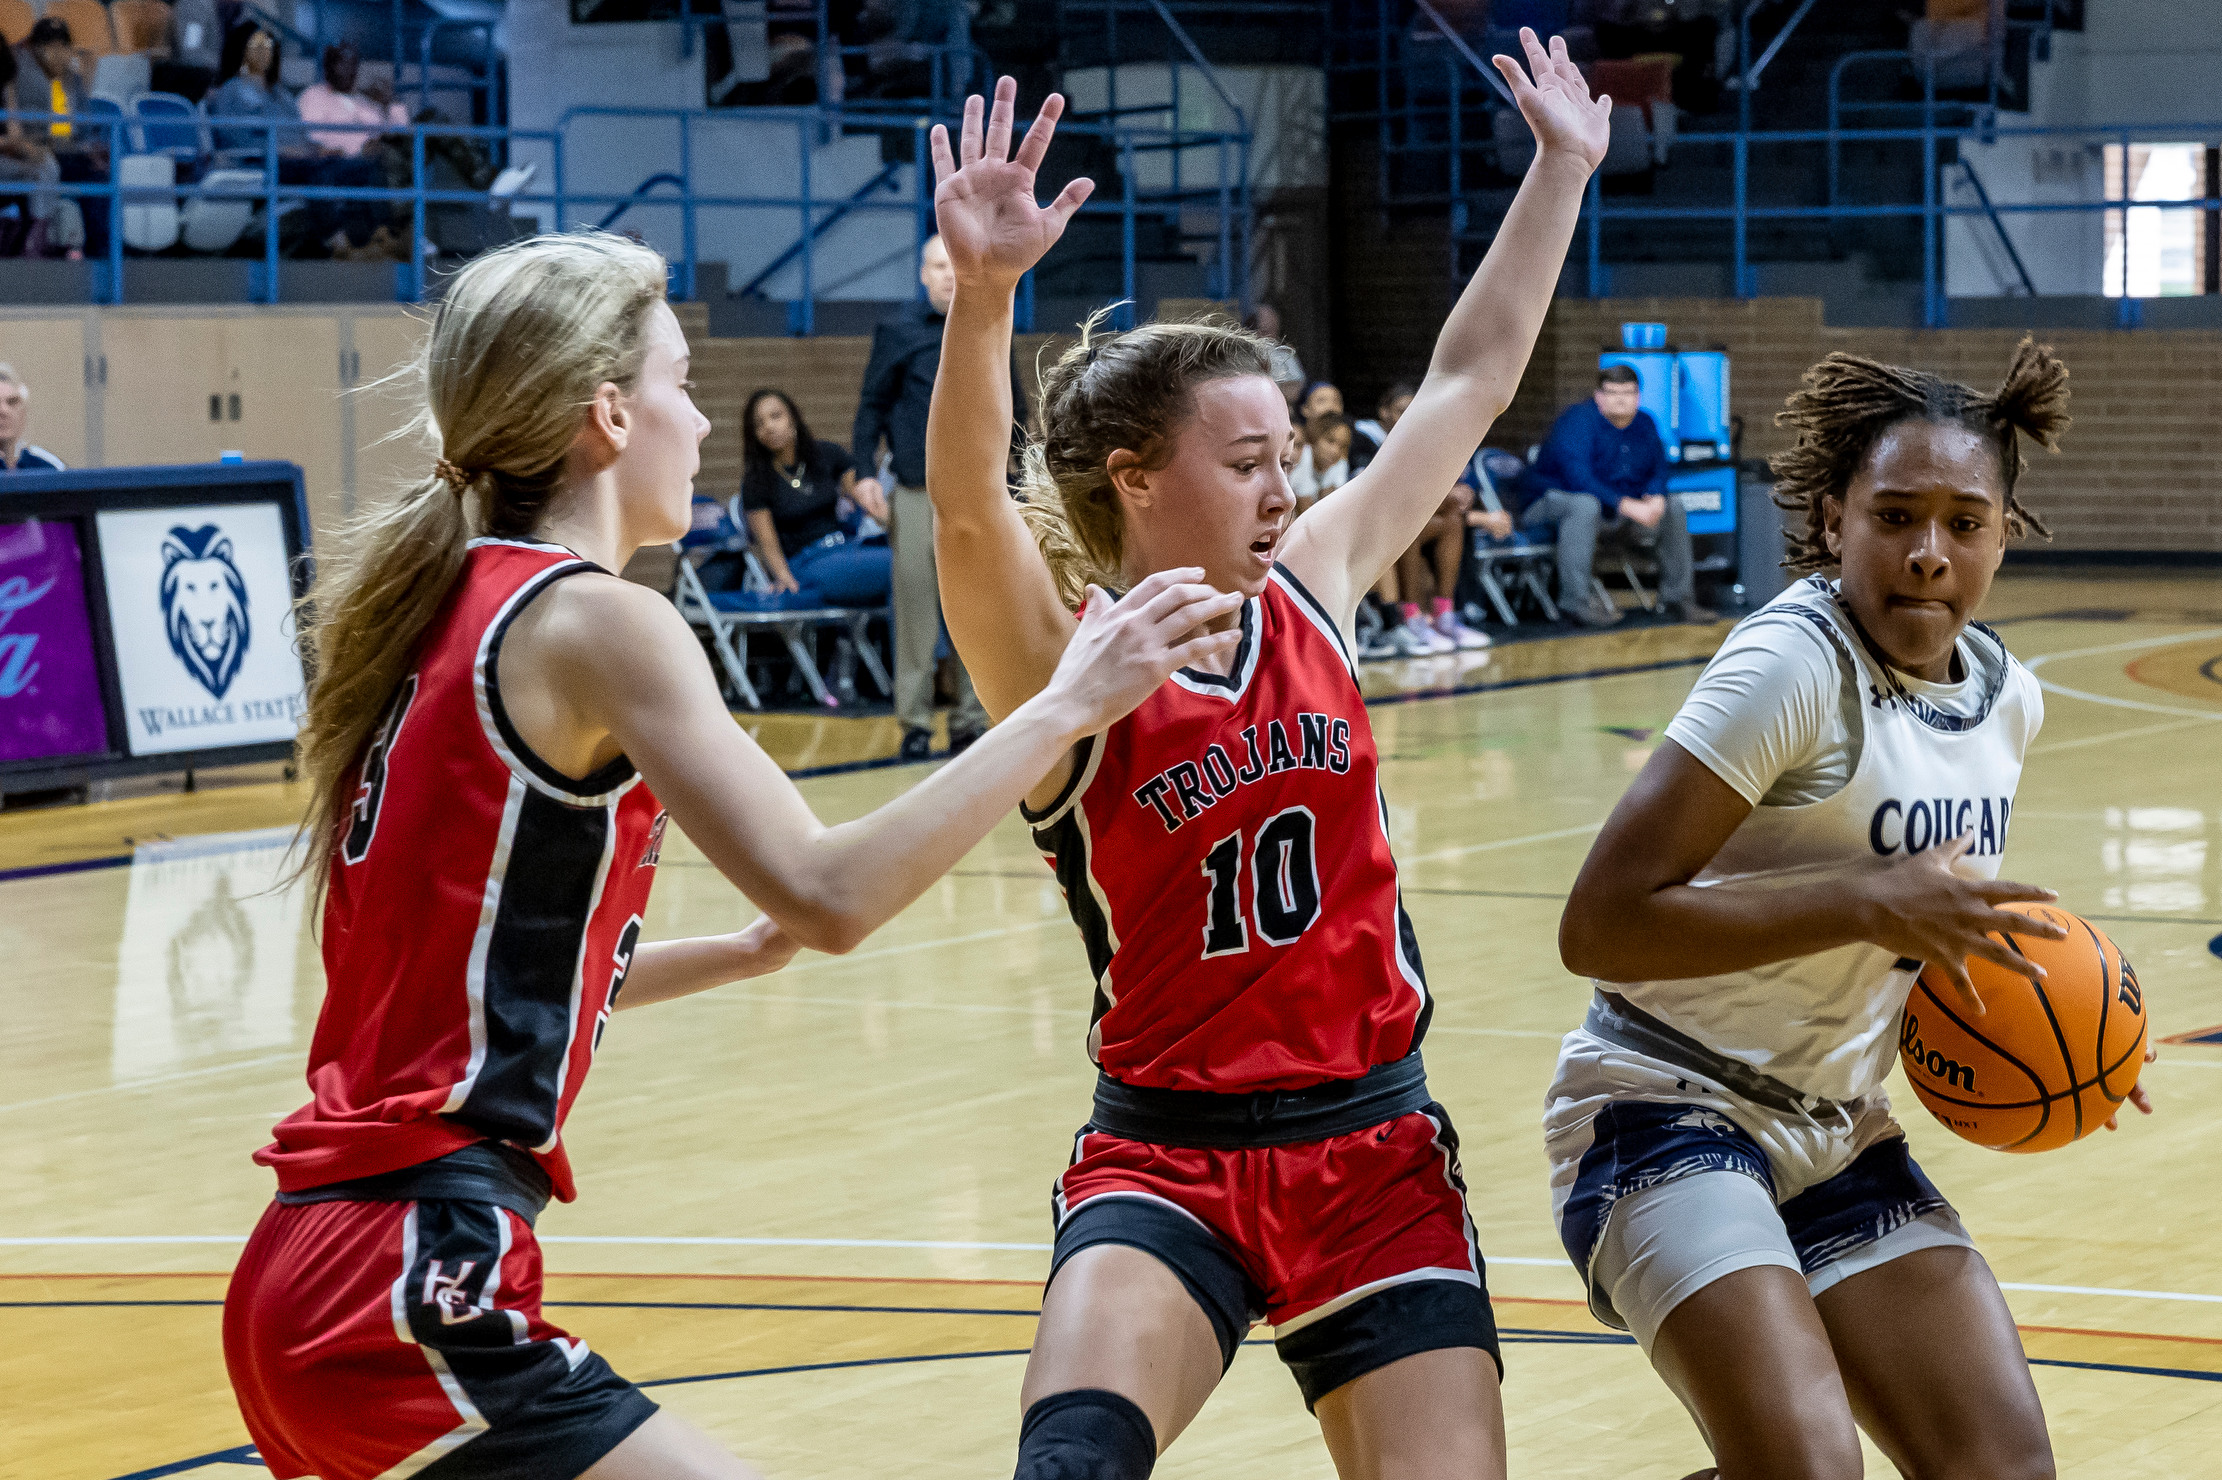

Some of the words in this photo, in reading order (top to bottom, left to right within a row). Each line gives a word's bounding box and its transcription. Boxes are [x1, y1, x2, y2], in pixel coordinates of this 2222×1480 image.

[1132, 712, 1351, 834] TROJANS
[1868, 797, 2014, 857] COUGAR
[1200, 805, 1322, 961] 10
